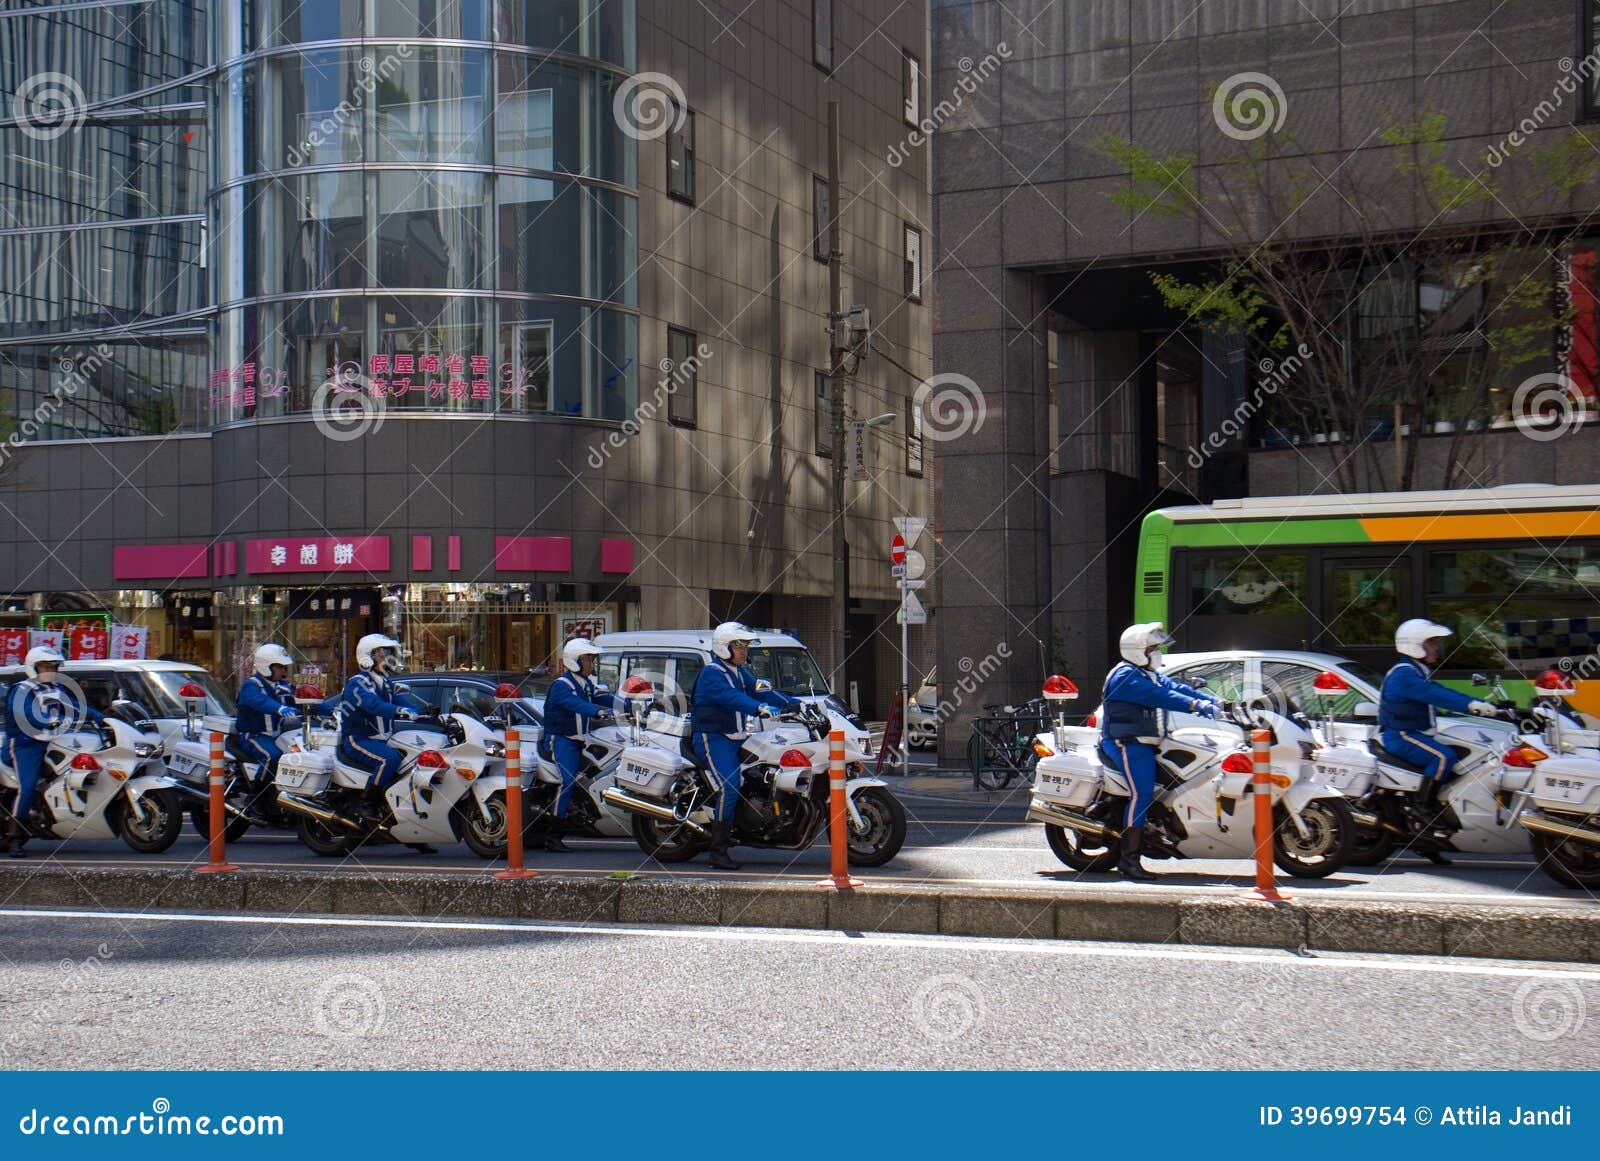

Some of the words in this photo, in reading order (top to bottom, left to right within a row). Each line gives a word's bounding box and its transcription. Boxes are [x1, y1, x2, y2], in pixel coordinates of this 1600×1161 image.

[368, 354, 490, 375] 假屋崎省吾
